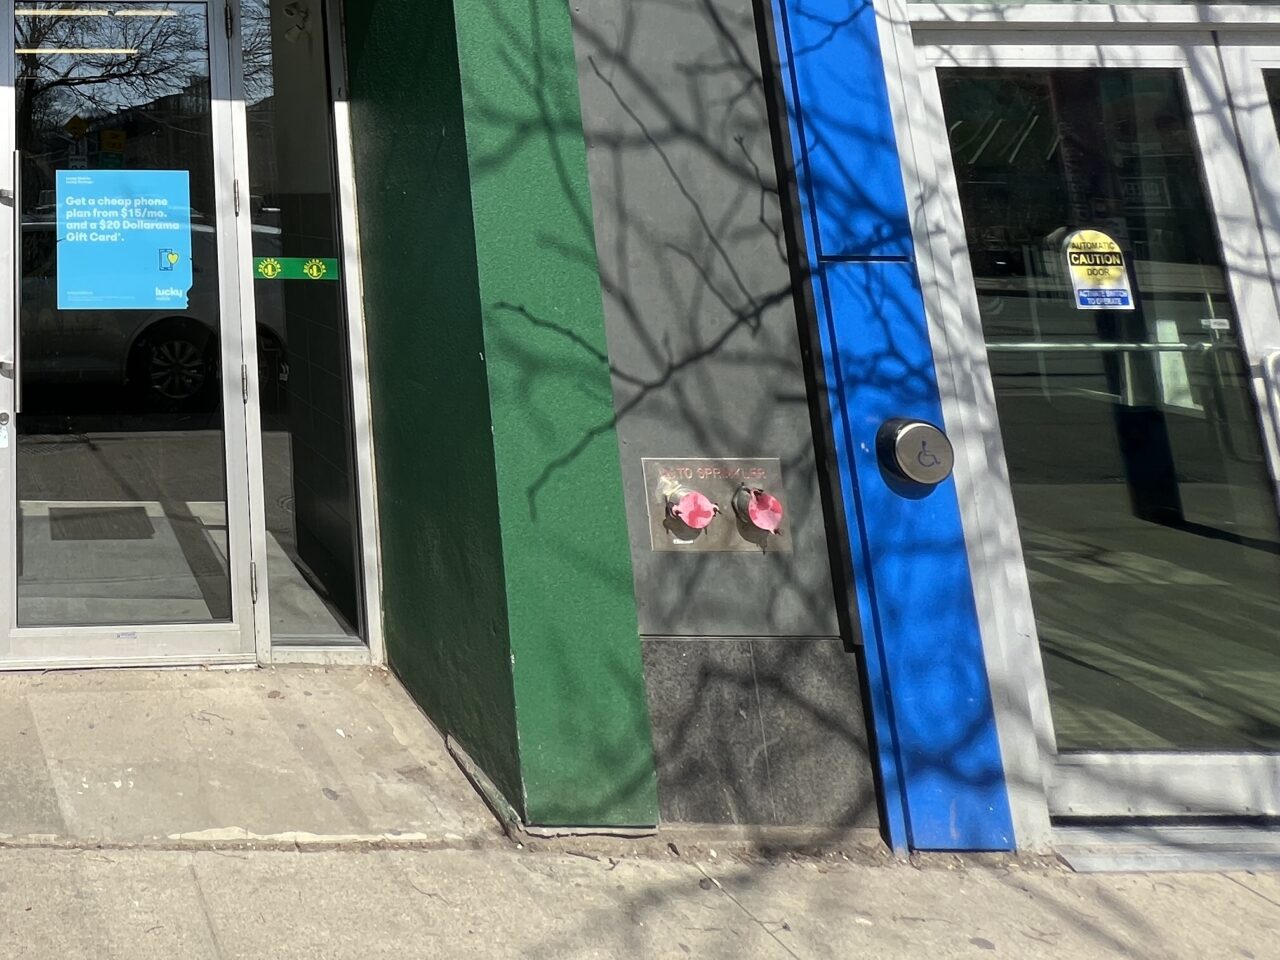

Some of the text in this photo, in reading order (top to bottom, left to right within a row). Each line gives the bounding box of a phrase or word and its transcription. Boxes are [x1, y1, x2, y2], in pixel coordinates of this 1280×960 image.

[65, 196, 168, 208] Get a cheap phone
[66, 208, 91, 219] plan
[93, 208, 118, 218] from
[66, 220, 180, 231] and a $20 Dollarama
[66, 232, 88, 242] Gift
[1071, 242, 1115, 250] AUTOMATIC
[1070, 253, 1121, 265] CAUTION
[1087, 268, 1110, 276] DOOR
[155, 287, 183, 298] lucky
